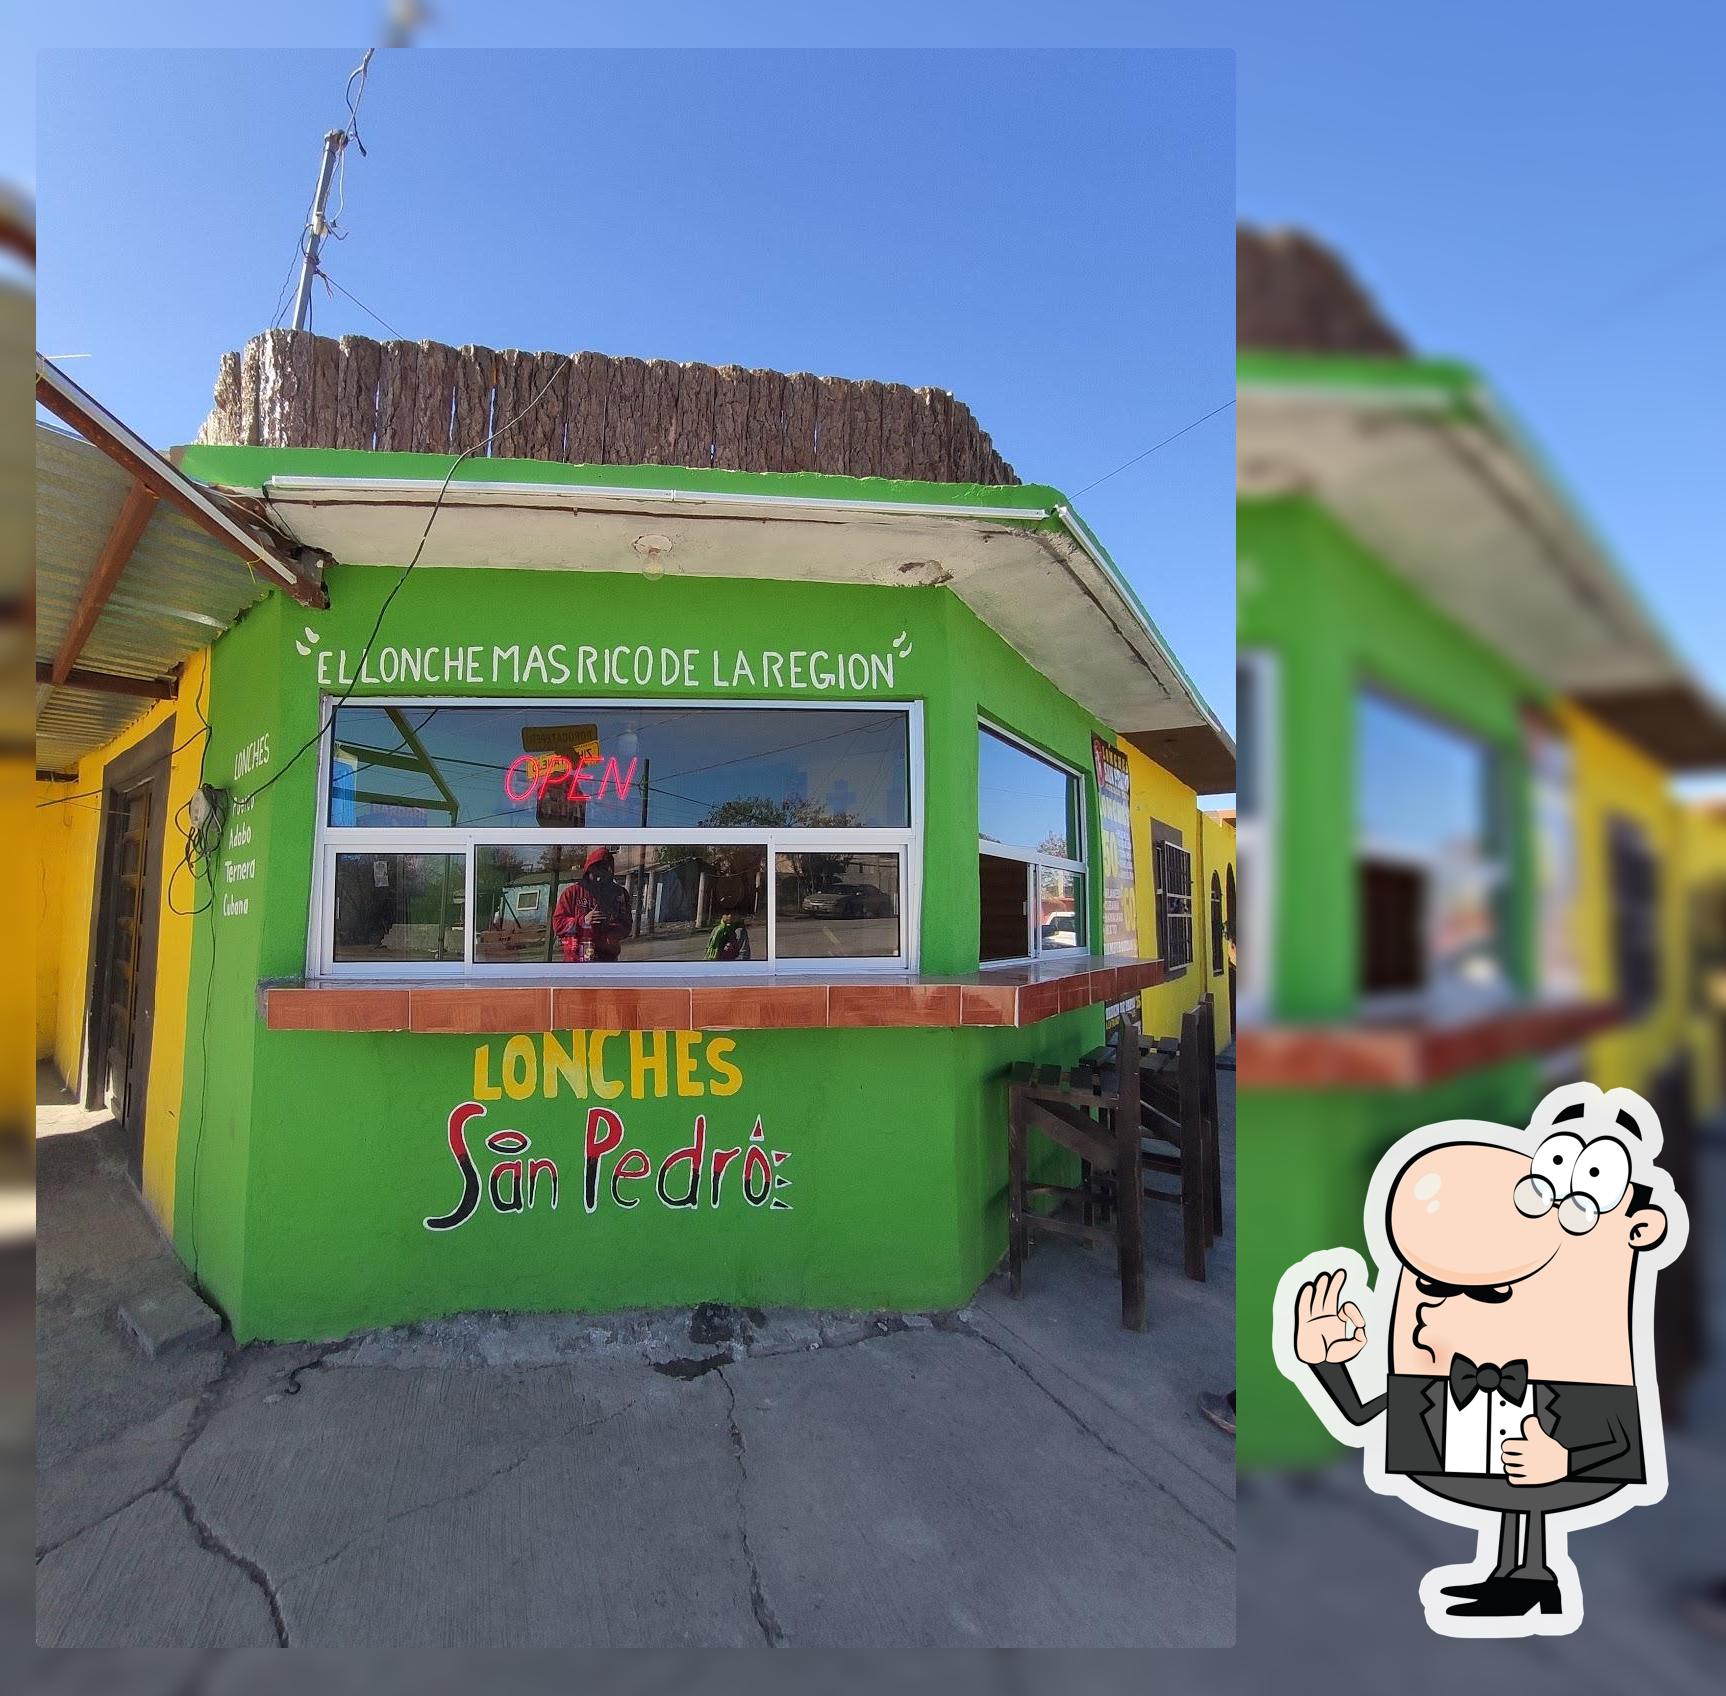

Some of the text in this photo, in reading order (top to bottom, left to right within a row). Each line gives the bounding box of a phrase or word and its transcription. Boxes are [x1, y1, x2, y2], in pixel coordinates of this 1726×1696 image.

[361, 646, 484, 684] LONCHE
[493, 644, 570, 685] MAS
[578, 645, 654, 686] RICO
[660, 647, 700, 687] DE
[713, 650, 756, 687] LA
[234, 732, 270, 781] LONCHES
[505, 755, 638, 800] OPEN
[228, 822, 252, 850] Adobo
[224, 858, 256, 884] Ternera
[222, 892, 249, 917] Cubana
[473, 1029, 744, 1100] LONCHES
[423, 1101, 774, 1232] San Pedro
